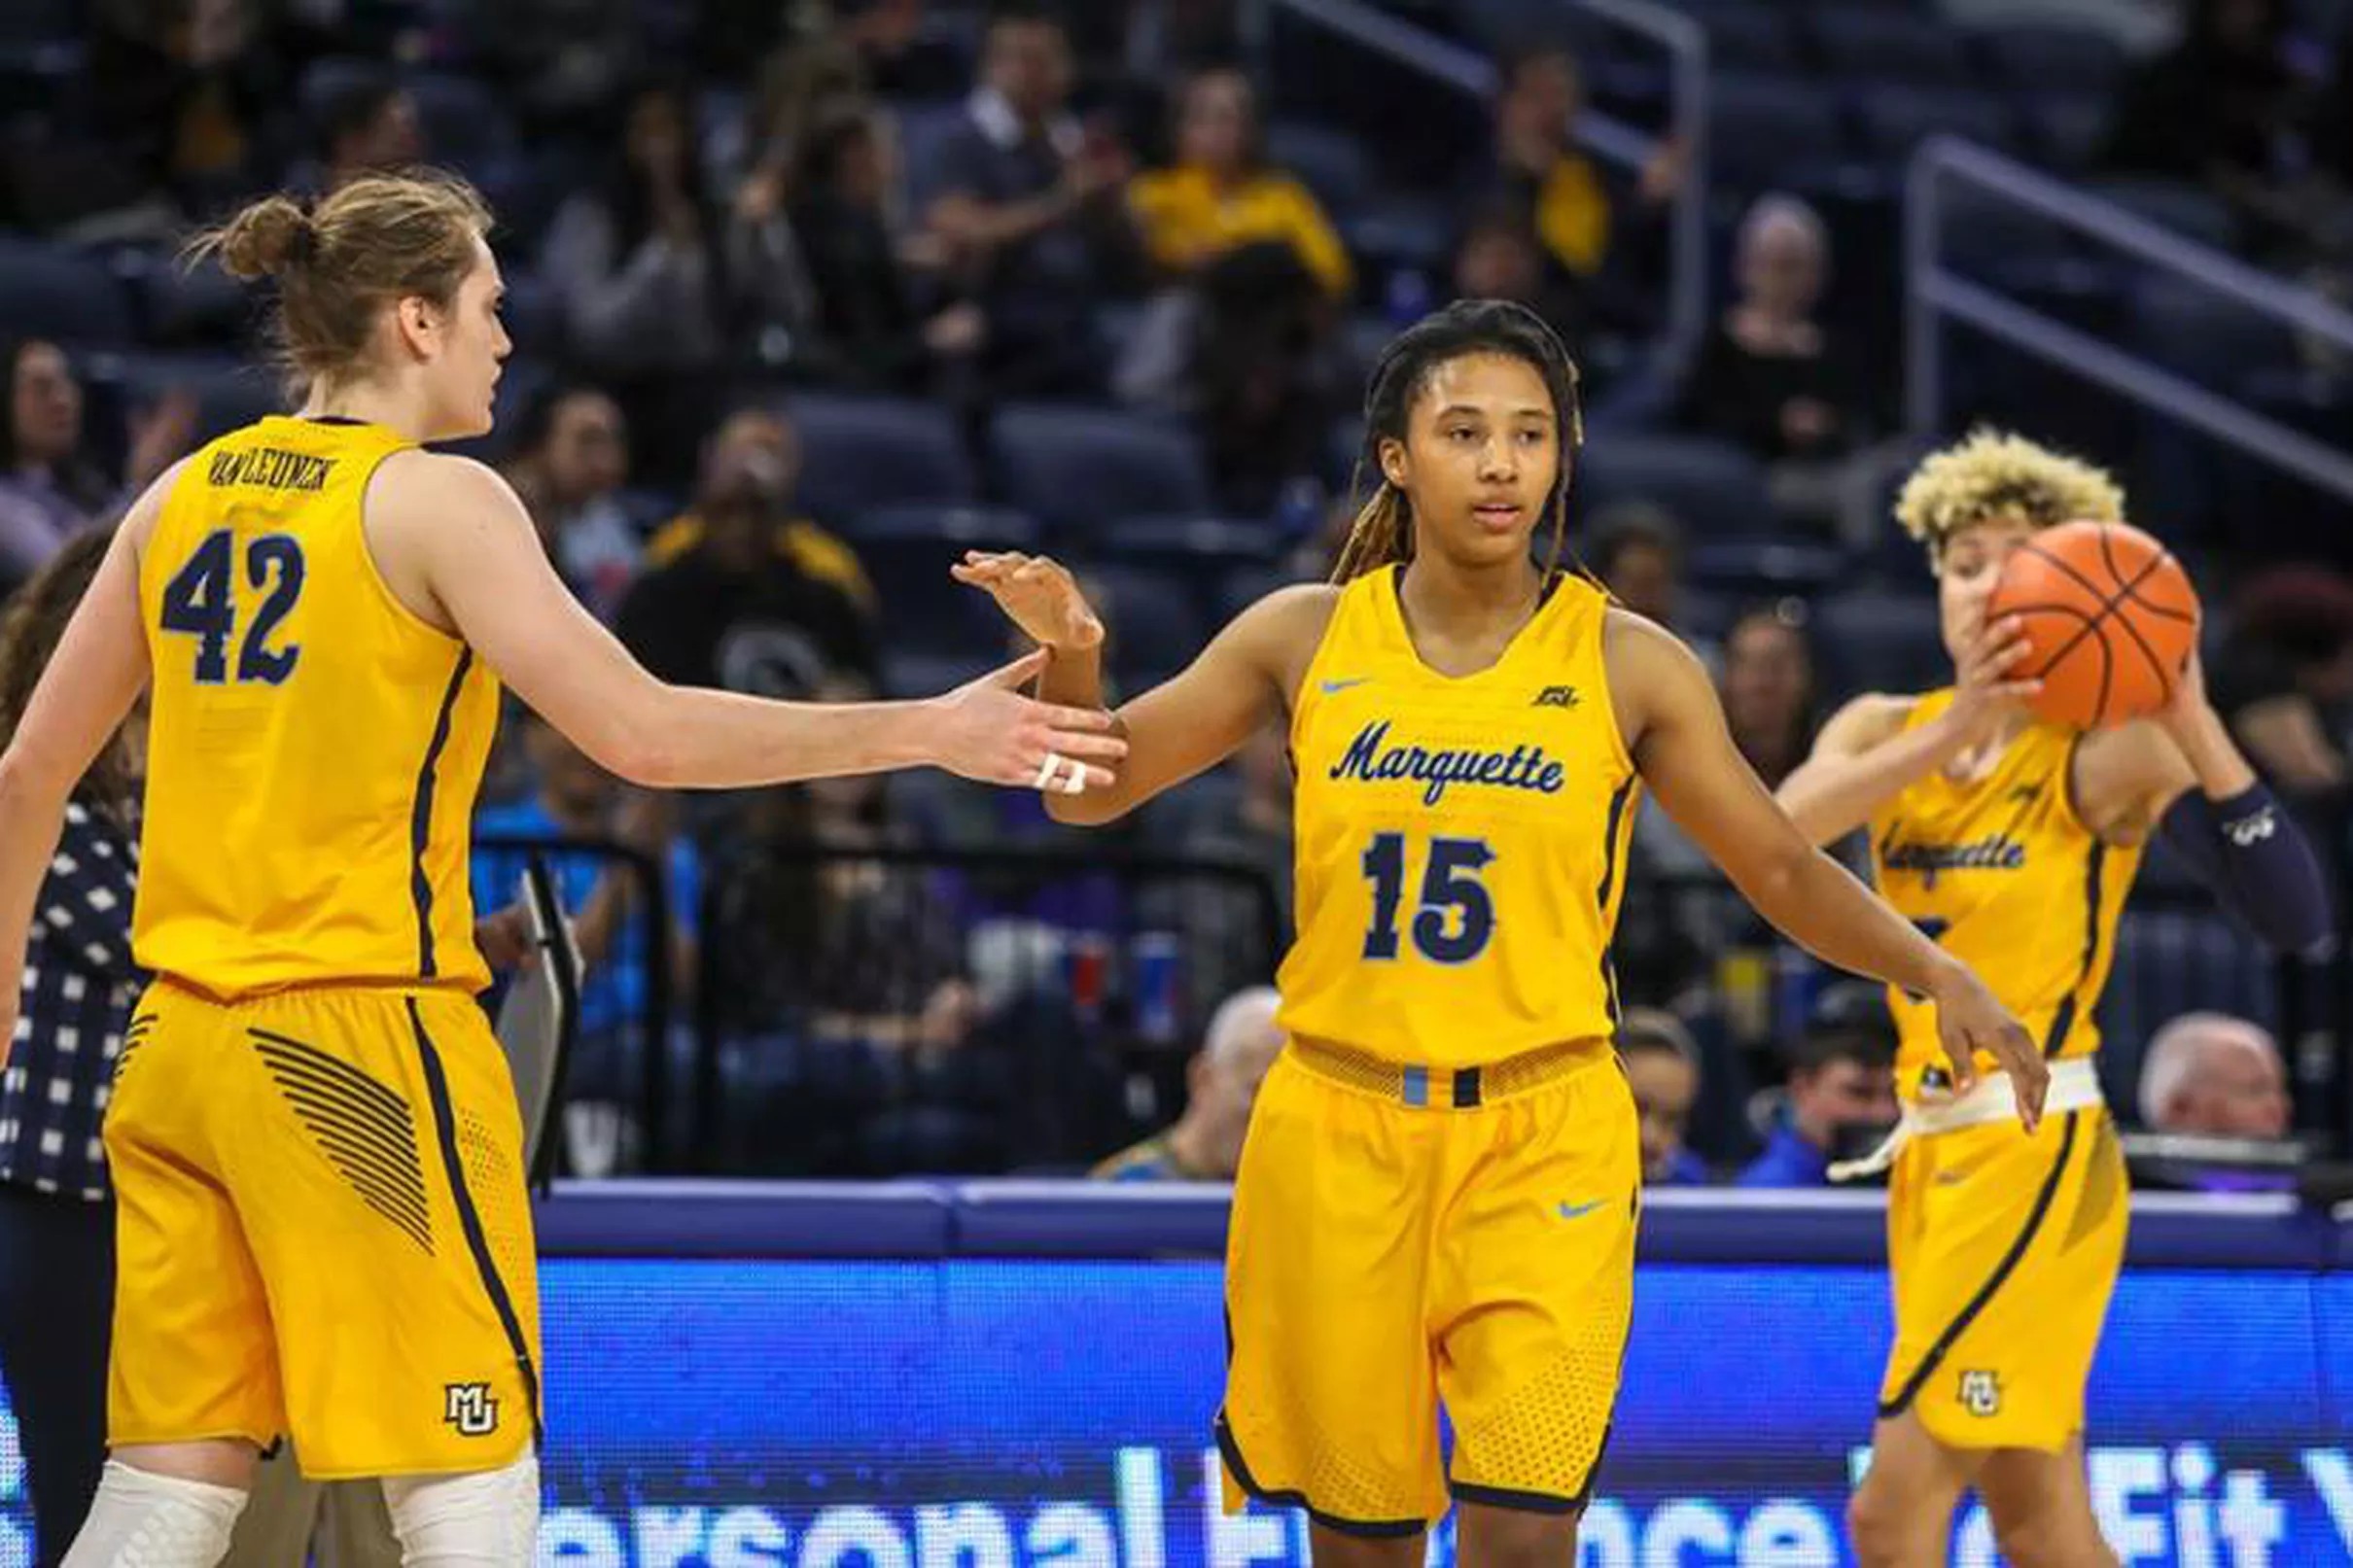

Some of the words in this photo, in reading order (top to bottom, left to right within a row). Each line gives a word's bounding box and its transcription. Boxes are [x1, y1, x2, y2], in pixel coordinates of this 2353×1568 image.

[158, 528, 306, 686] 42
[1329, 719, 1565, 808] Marquette
[1361, 831, 1497, 966] 15
[444, 1382, 499, 1437] MU
[535, 1446, 1164, 1568] ersonal
[2088, 1441, 2287, 1568] Fit
